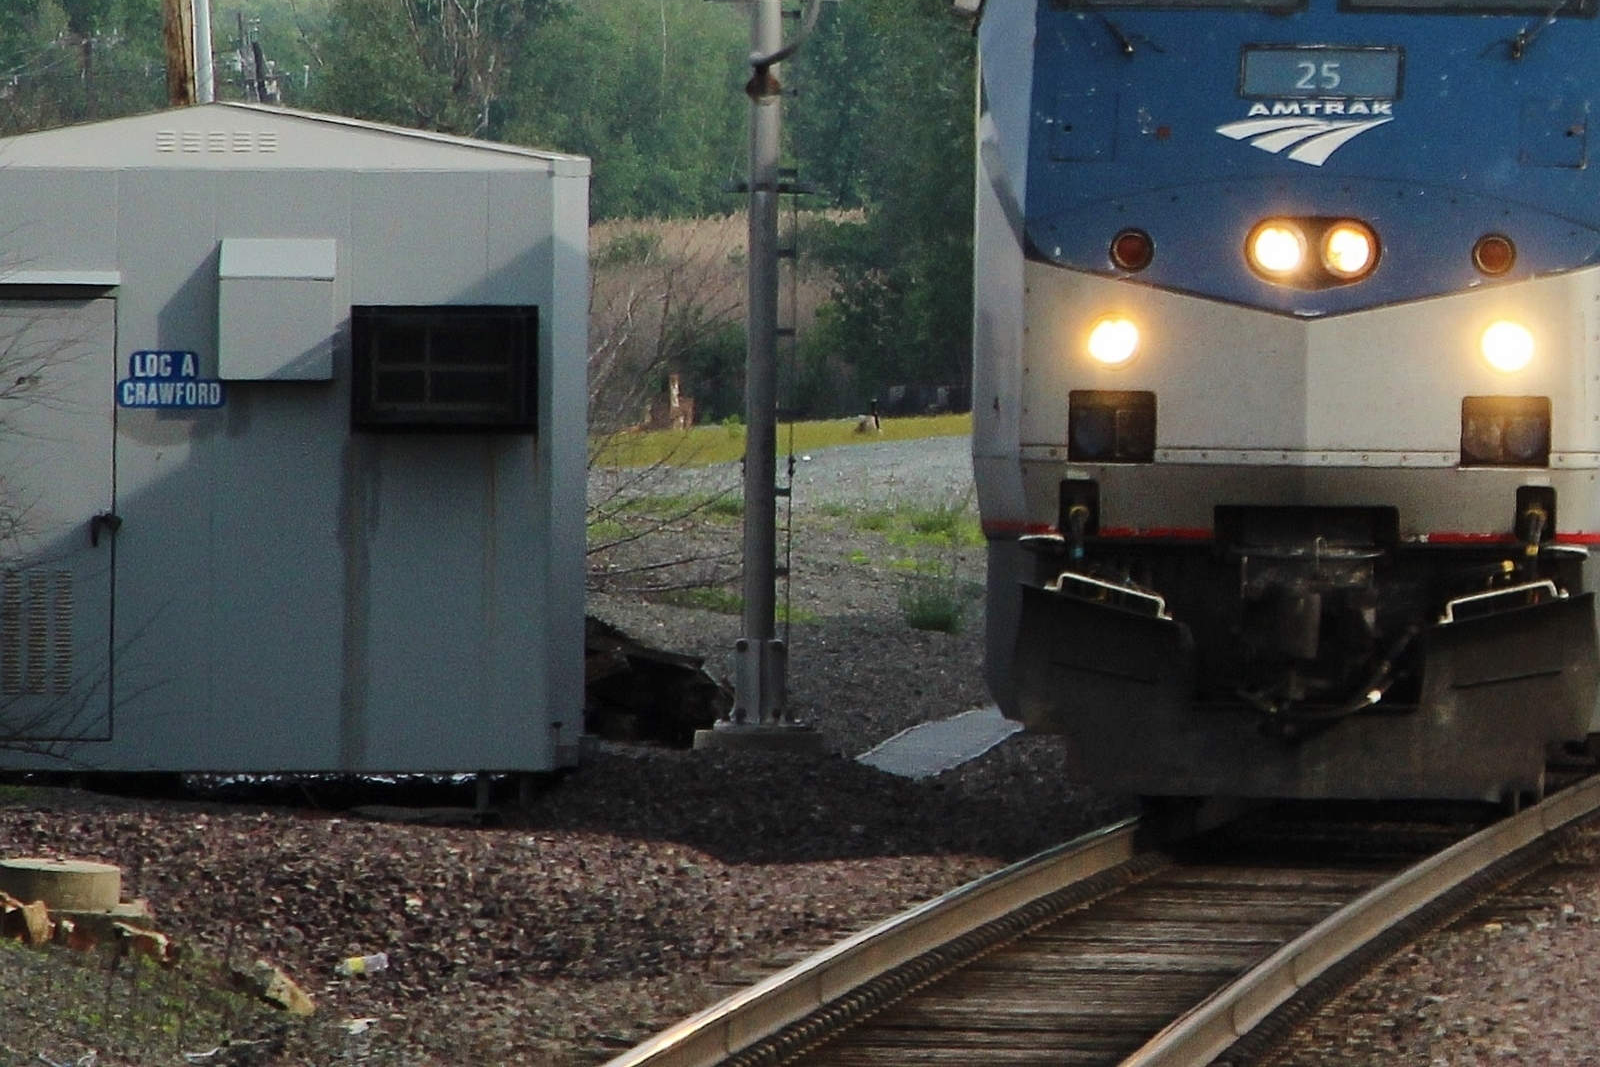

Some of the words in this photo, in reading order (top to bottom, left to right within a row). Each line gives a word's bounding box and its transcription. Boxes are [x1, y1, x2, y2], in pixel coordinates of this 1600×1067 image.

[1295, 63, 1341, 89] 25
[1248, 100, 1393, 116] AMTRAK
[134, 354, 172, 377] LOC
[181, 354, 195, 377] A
[123, 382, 221, 405] CRAWFORD
